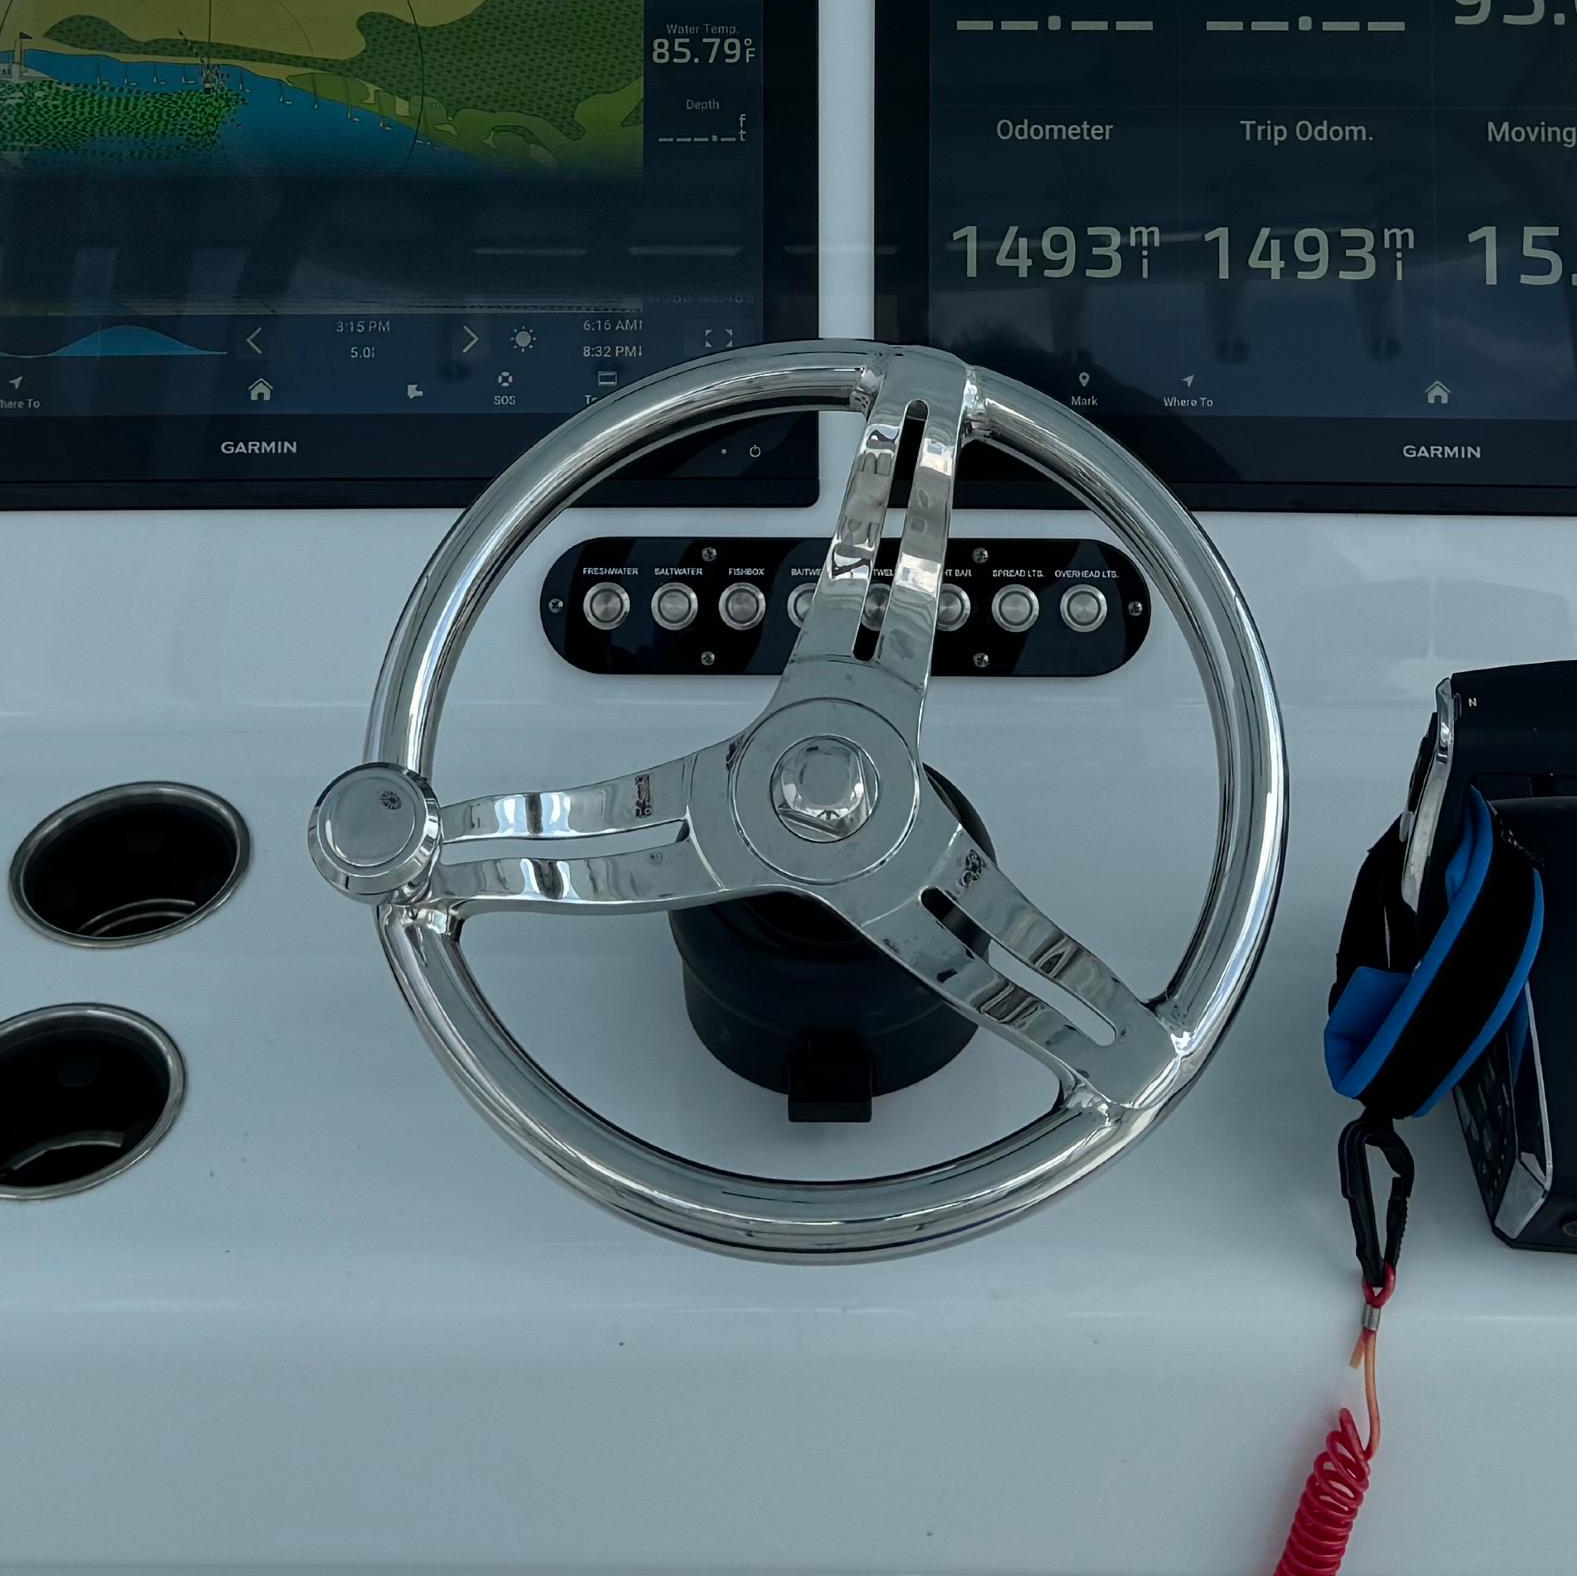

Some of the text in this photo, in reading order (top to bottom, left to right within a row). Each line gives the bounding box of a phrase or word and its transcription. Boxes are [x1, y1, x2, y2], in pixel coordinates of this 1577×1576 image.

[667, 24, 740, 37] Water Temp.
[652, 38, 743, 63] 85.79
[686, 99, 720, 112] Depth
[996, 120, 1114, 141] Odometer
[1240, 120, 1373, 145] Trip Odom.
[1488, 122, 1576, 147] Moving
[952, 225, 1123, 278] 1493
[1204, 227, 1377, 280] 1493
[336, 320, 391, 332] 3:15 PM
[583, 320, 637, 331] 6:16 AM
[583, 346, 637, 358] 8:32 PM
[27, 398, 41, 409] To
[494, 395, 516, 405] SOS
[1071, 395, 1099, 406] Mark
[1163, 395, 1215, 407] Where To
[220, 441, 298, 454] GARMIN
[1402, 445, 1482, 459] GARMIN
[583, 567, 639, 576] FRESHWATER
[654, 567, 703, 576] SALTWATER
[728, 567, 765, 576] FISHBOX
[954, 569, 972, 577] BAR
[992, 569, 1025, 578] SPREAD
[1054, 569, 1100, 579] OVERHEAD
